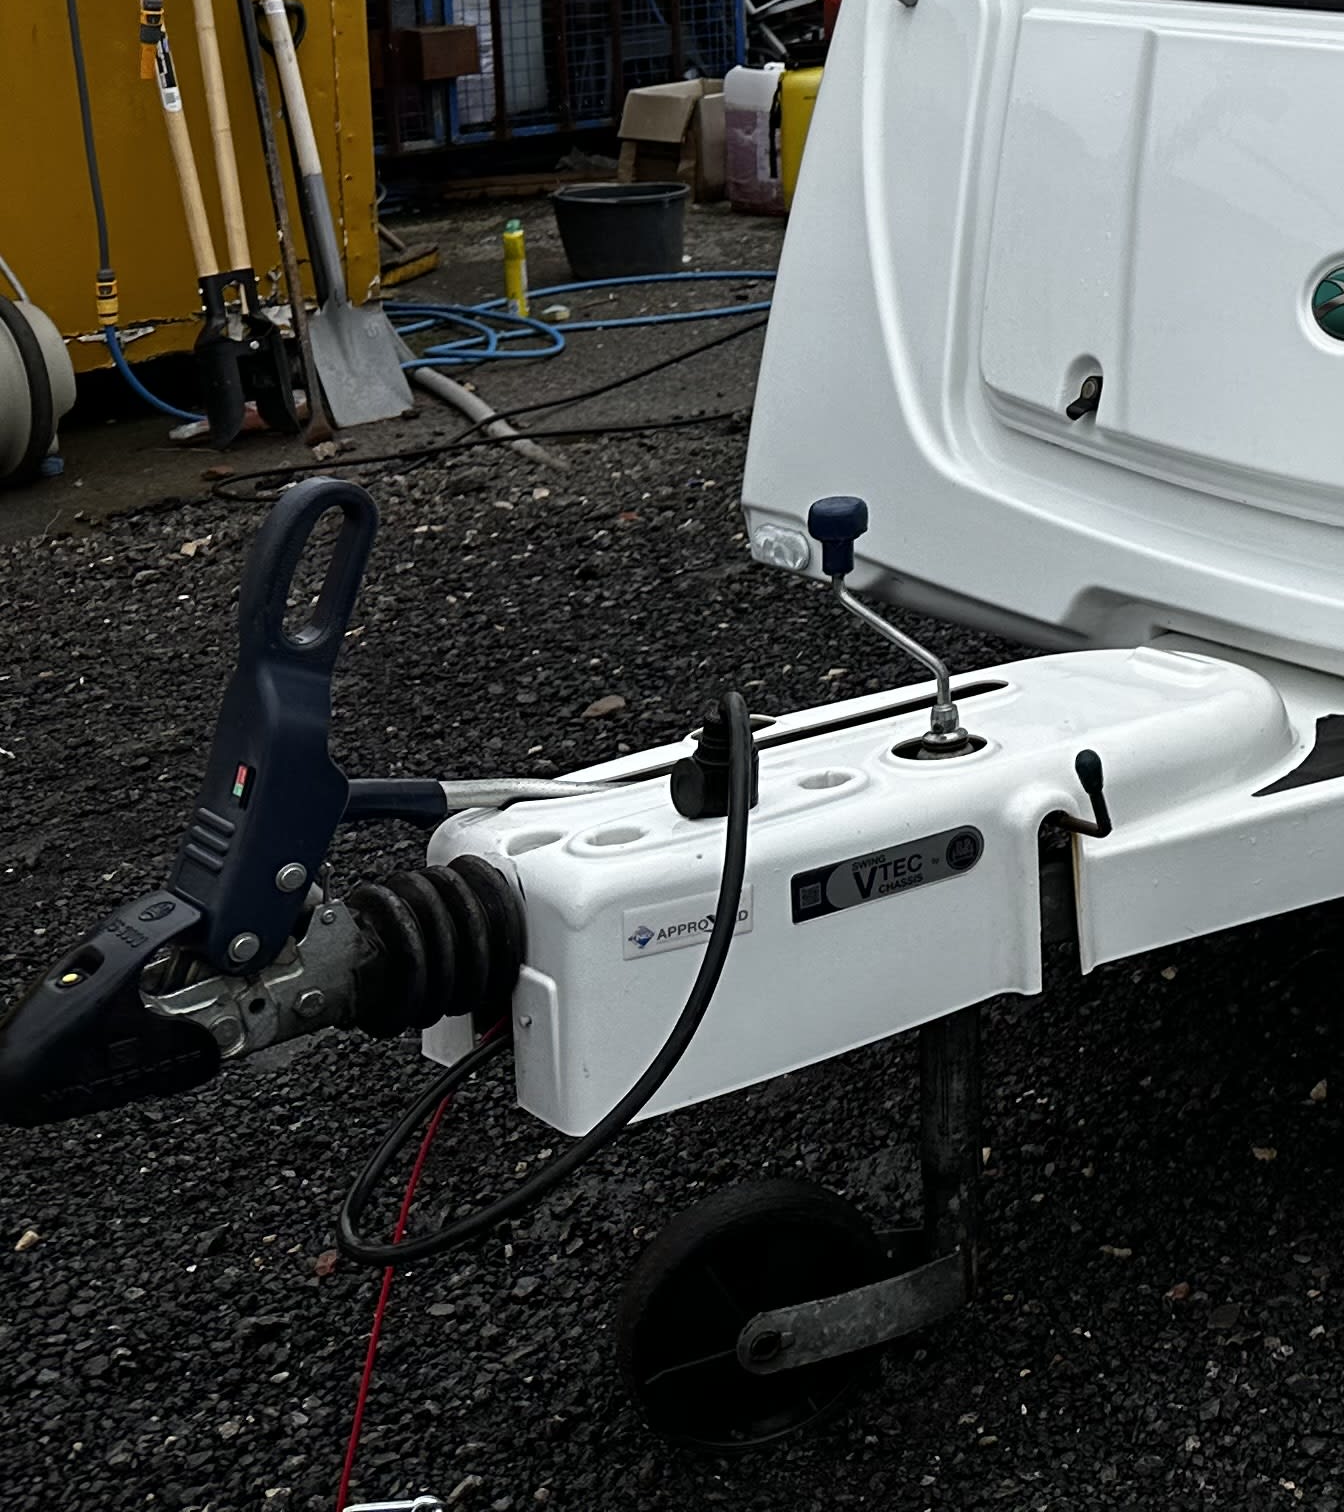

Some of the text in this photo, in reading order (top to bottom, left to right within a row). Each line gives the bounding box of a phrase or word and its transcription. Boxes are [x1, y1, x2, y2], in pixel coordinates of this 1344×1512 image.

[851, 854, 887, 872] SWING
[878, 873, 924, 895] CHASSIS
[656, 909, 749, 941] APPROD
